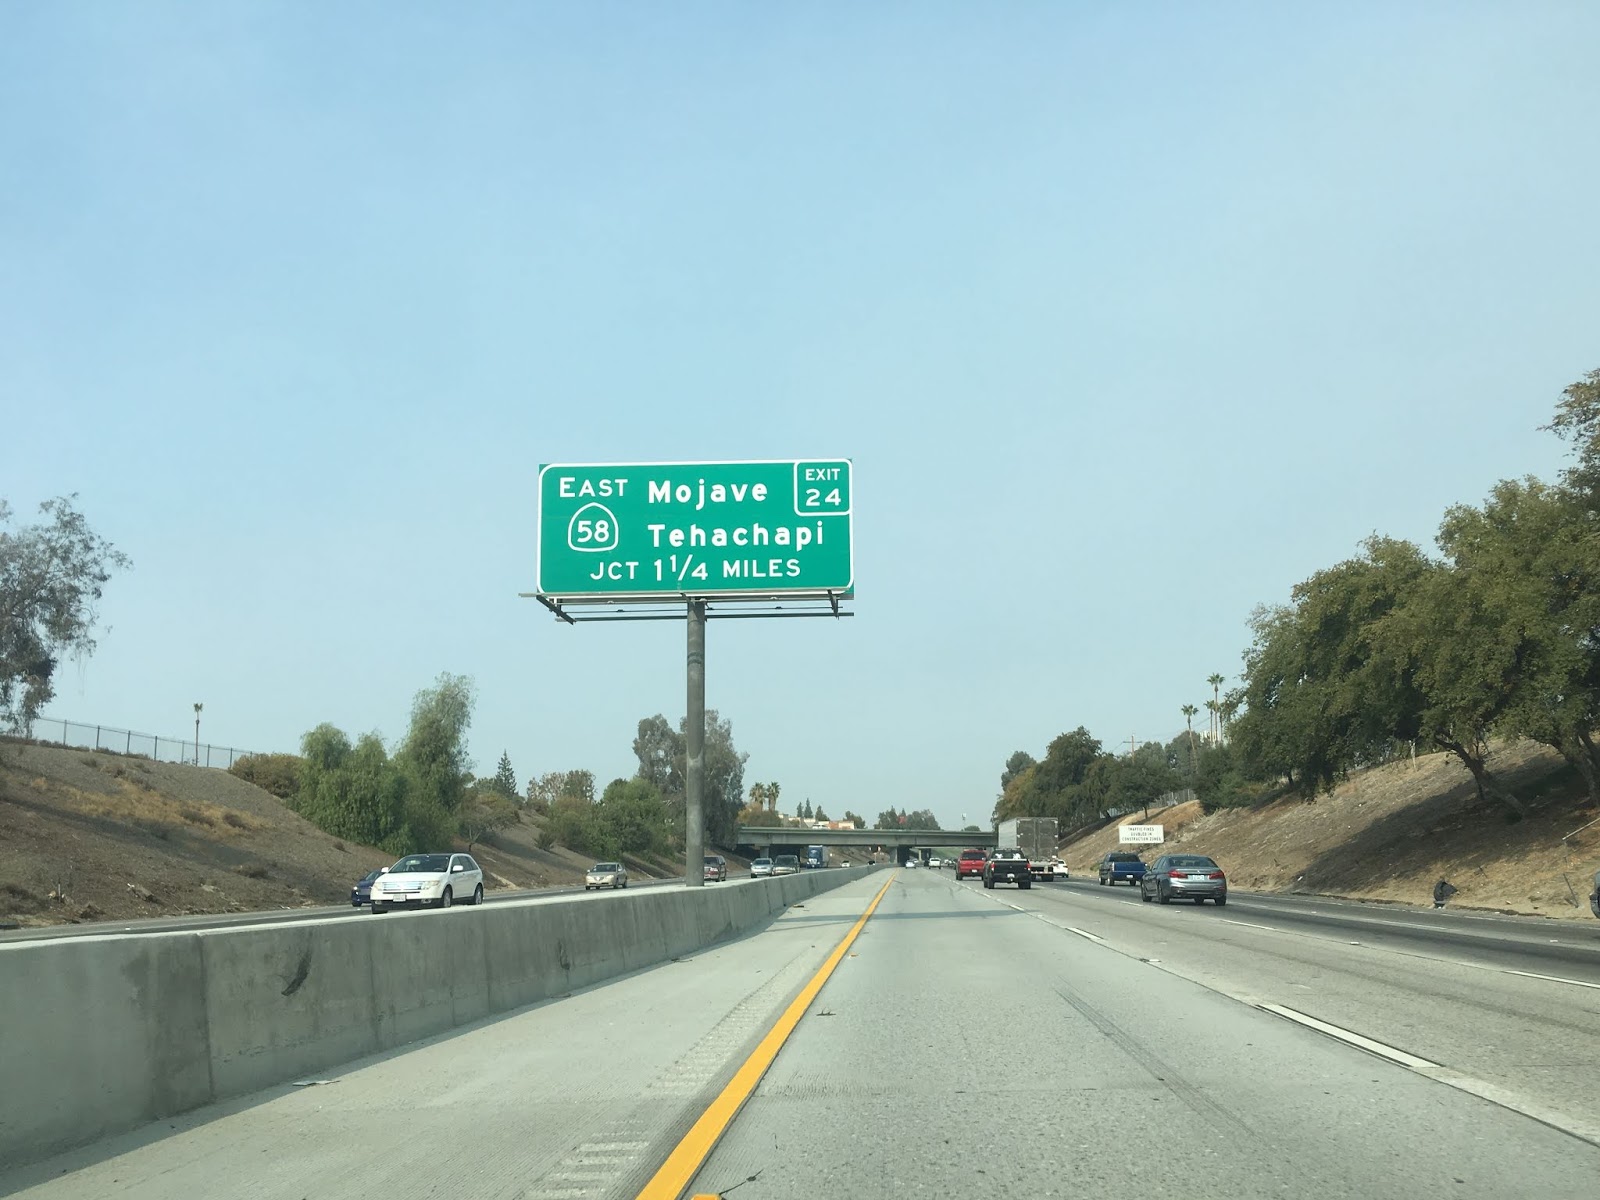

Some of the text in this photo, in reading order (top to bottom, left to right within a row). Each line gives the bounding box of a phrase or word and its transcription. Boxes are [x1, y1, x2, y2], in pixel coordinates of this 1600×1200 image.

[805, 468, 841, 481] EXIT
[559, 477, 629, 498] EAST
[648, 479, 768, 511] Mojave
[805, 488, 842, 506] 24
[577, 520, 609, 543] 58
[648, 521, 824, 551] Tehachapi
[590, 561, 639, 580] JCT
[723, 559, 801, 578] MILES
